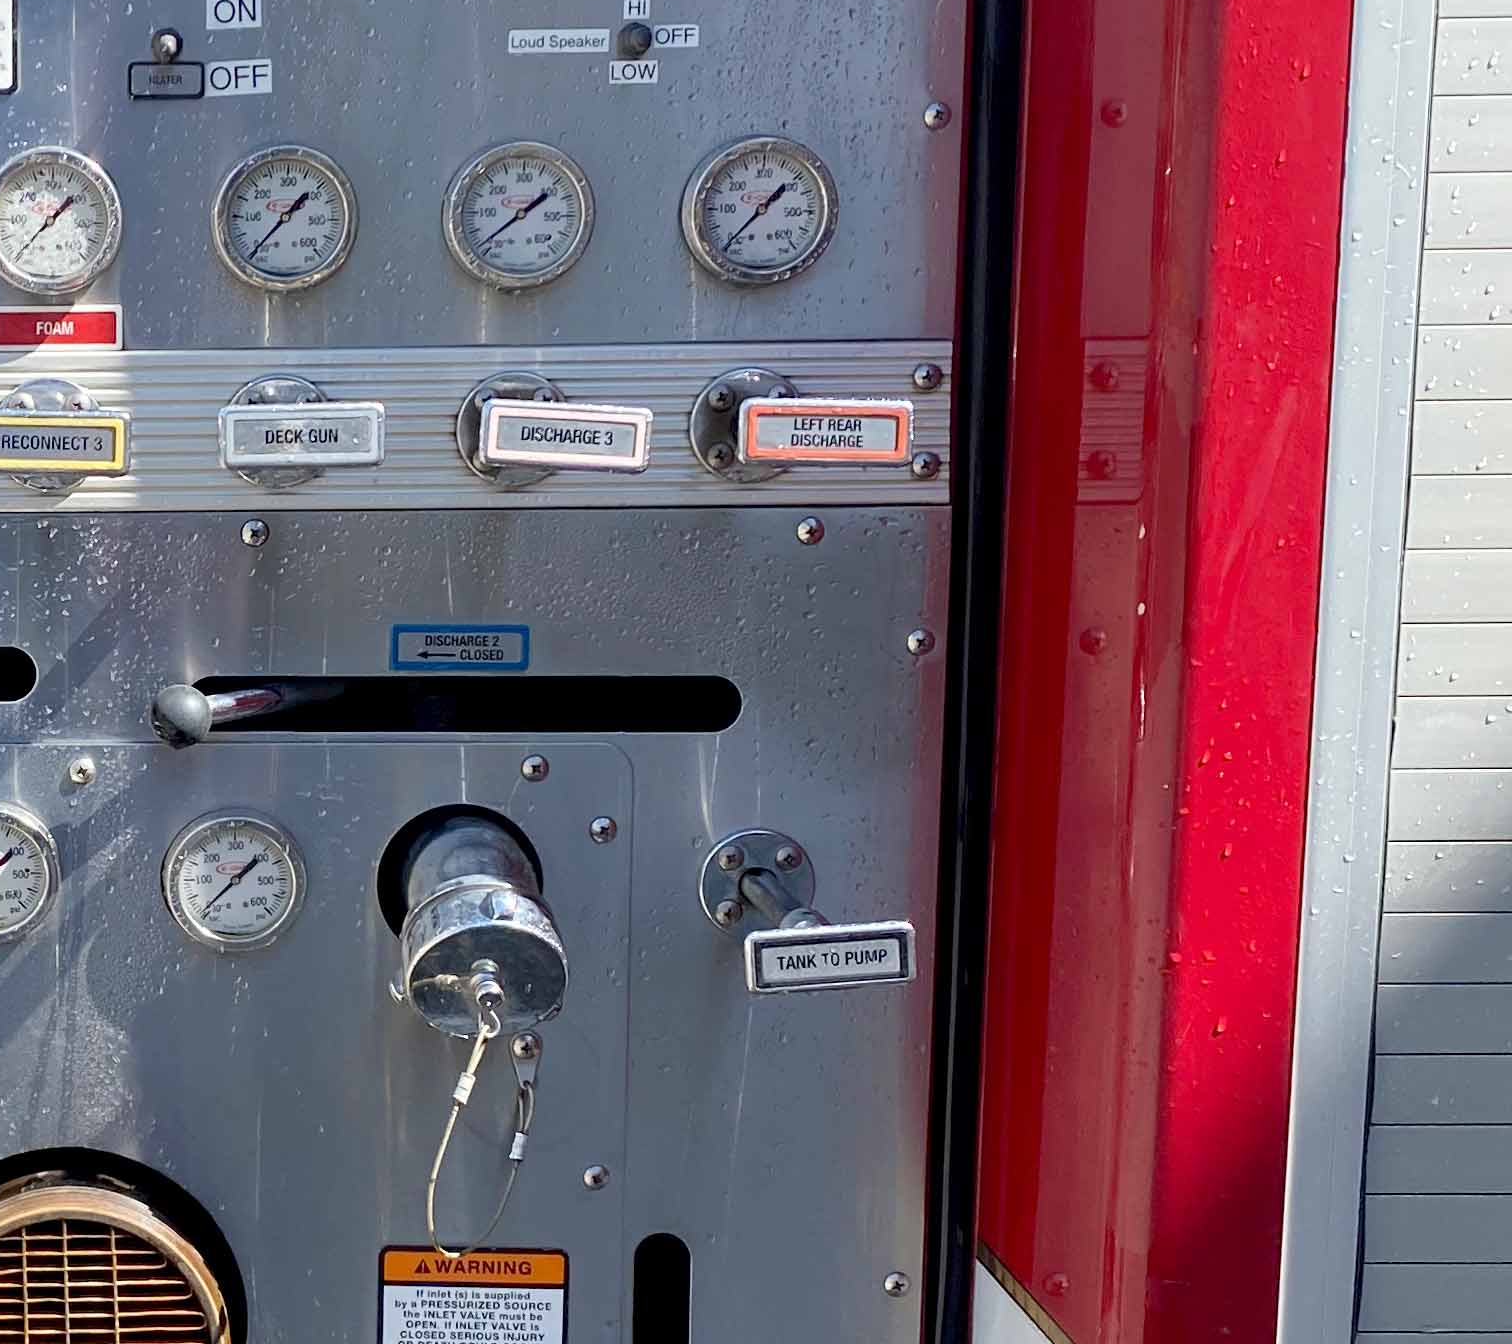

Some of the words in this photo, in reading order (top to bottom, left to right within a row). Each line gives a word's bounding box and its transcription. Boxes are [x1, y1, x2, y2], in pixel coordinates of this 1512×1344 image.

[213, 0, 257, 24] ON
[627, 0, 647, 16] HI
[510, 34, 544, 49] Loud
[548, 34, 607, 51] Speaker
[655, 27, 695, 45] OFF
[209, 64, 270, 91] OFF
[611, 63, 657, 81] LOW
[36, 321, 74, 336] FOAM
[793, 418, 822, 432] LEFT
[826, 418, 862, 432] REAR
[264, 428, 303, 445] DECK
[307, 428, 339, 444] GUN
[520, 426, 598, 445] DISCHARGE
[603, 430, 614, 445] 3
[790, 432, 864, 448] DISCHARGE
[93, 436, 103, 452] 3
[424, 635, 489, 647] DISCHARGE
[492, 636, 500, 646] 2
[459, 649, 504, 661] CLOSED
[195, 874, 213, 885] 100
[257, 875, 274, 886] 500
[250, 896, 267, 907] 600
[776, 954, 817, 971] TANK
[822, 951, 840, 967] TO
[845, 948, 887, 966] PUMP
[434, 1259, 533, 1276] WARNING
[416, 1290, 424, 1298] If
[427, 1289, 451, 1299] inlet
[454, 1290, 468, 1301] (s)
[471, 1290, 480, 1299] is
[484, 1291, 531, 1303] supplied
[394, 1300, 407, 1310] by
[420, 1300, 501, 1310] PRESSURIZED
[503, 1301, 552, 1311] SOURCE
[403, 1311, 421, 1319] the
[424, 1311, 456, 1319] INLET
[459, 1311, 495, 1320] VALVE
[499, 1312, 526, 1321] must
[529, 1312, 543, 1321] be
[444, 1321, 452, 1329] If
[455, 1321, 488, 1330] INLET
[491, 1322, 527, 1331] VALVE
[530, 1322, 540, 1331] is
[399, 1331, 446, 1340] CLOSED
[449, 1331, 500, 1341] SERIOUS
[503, 1332, 545, 1342] INJURY
